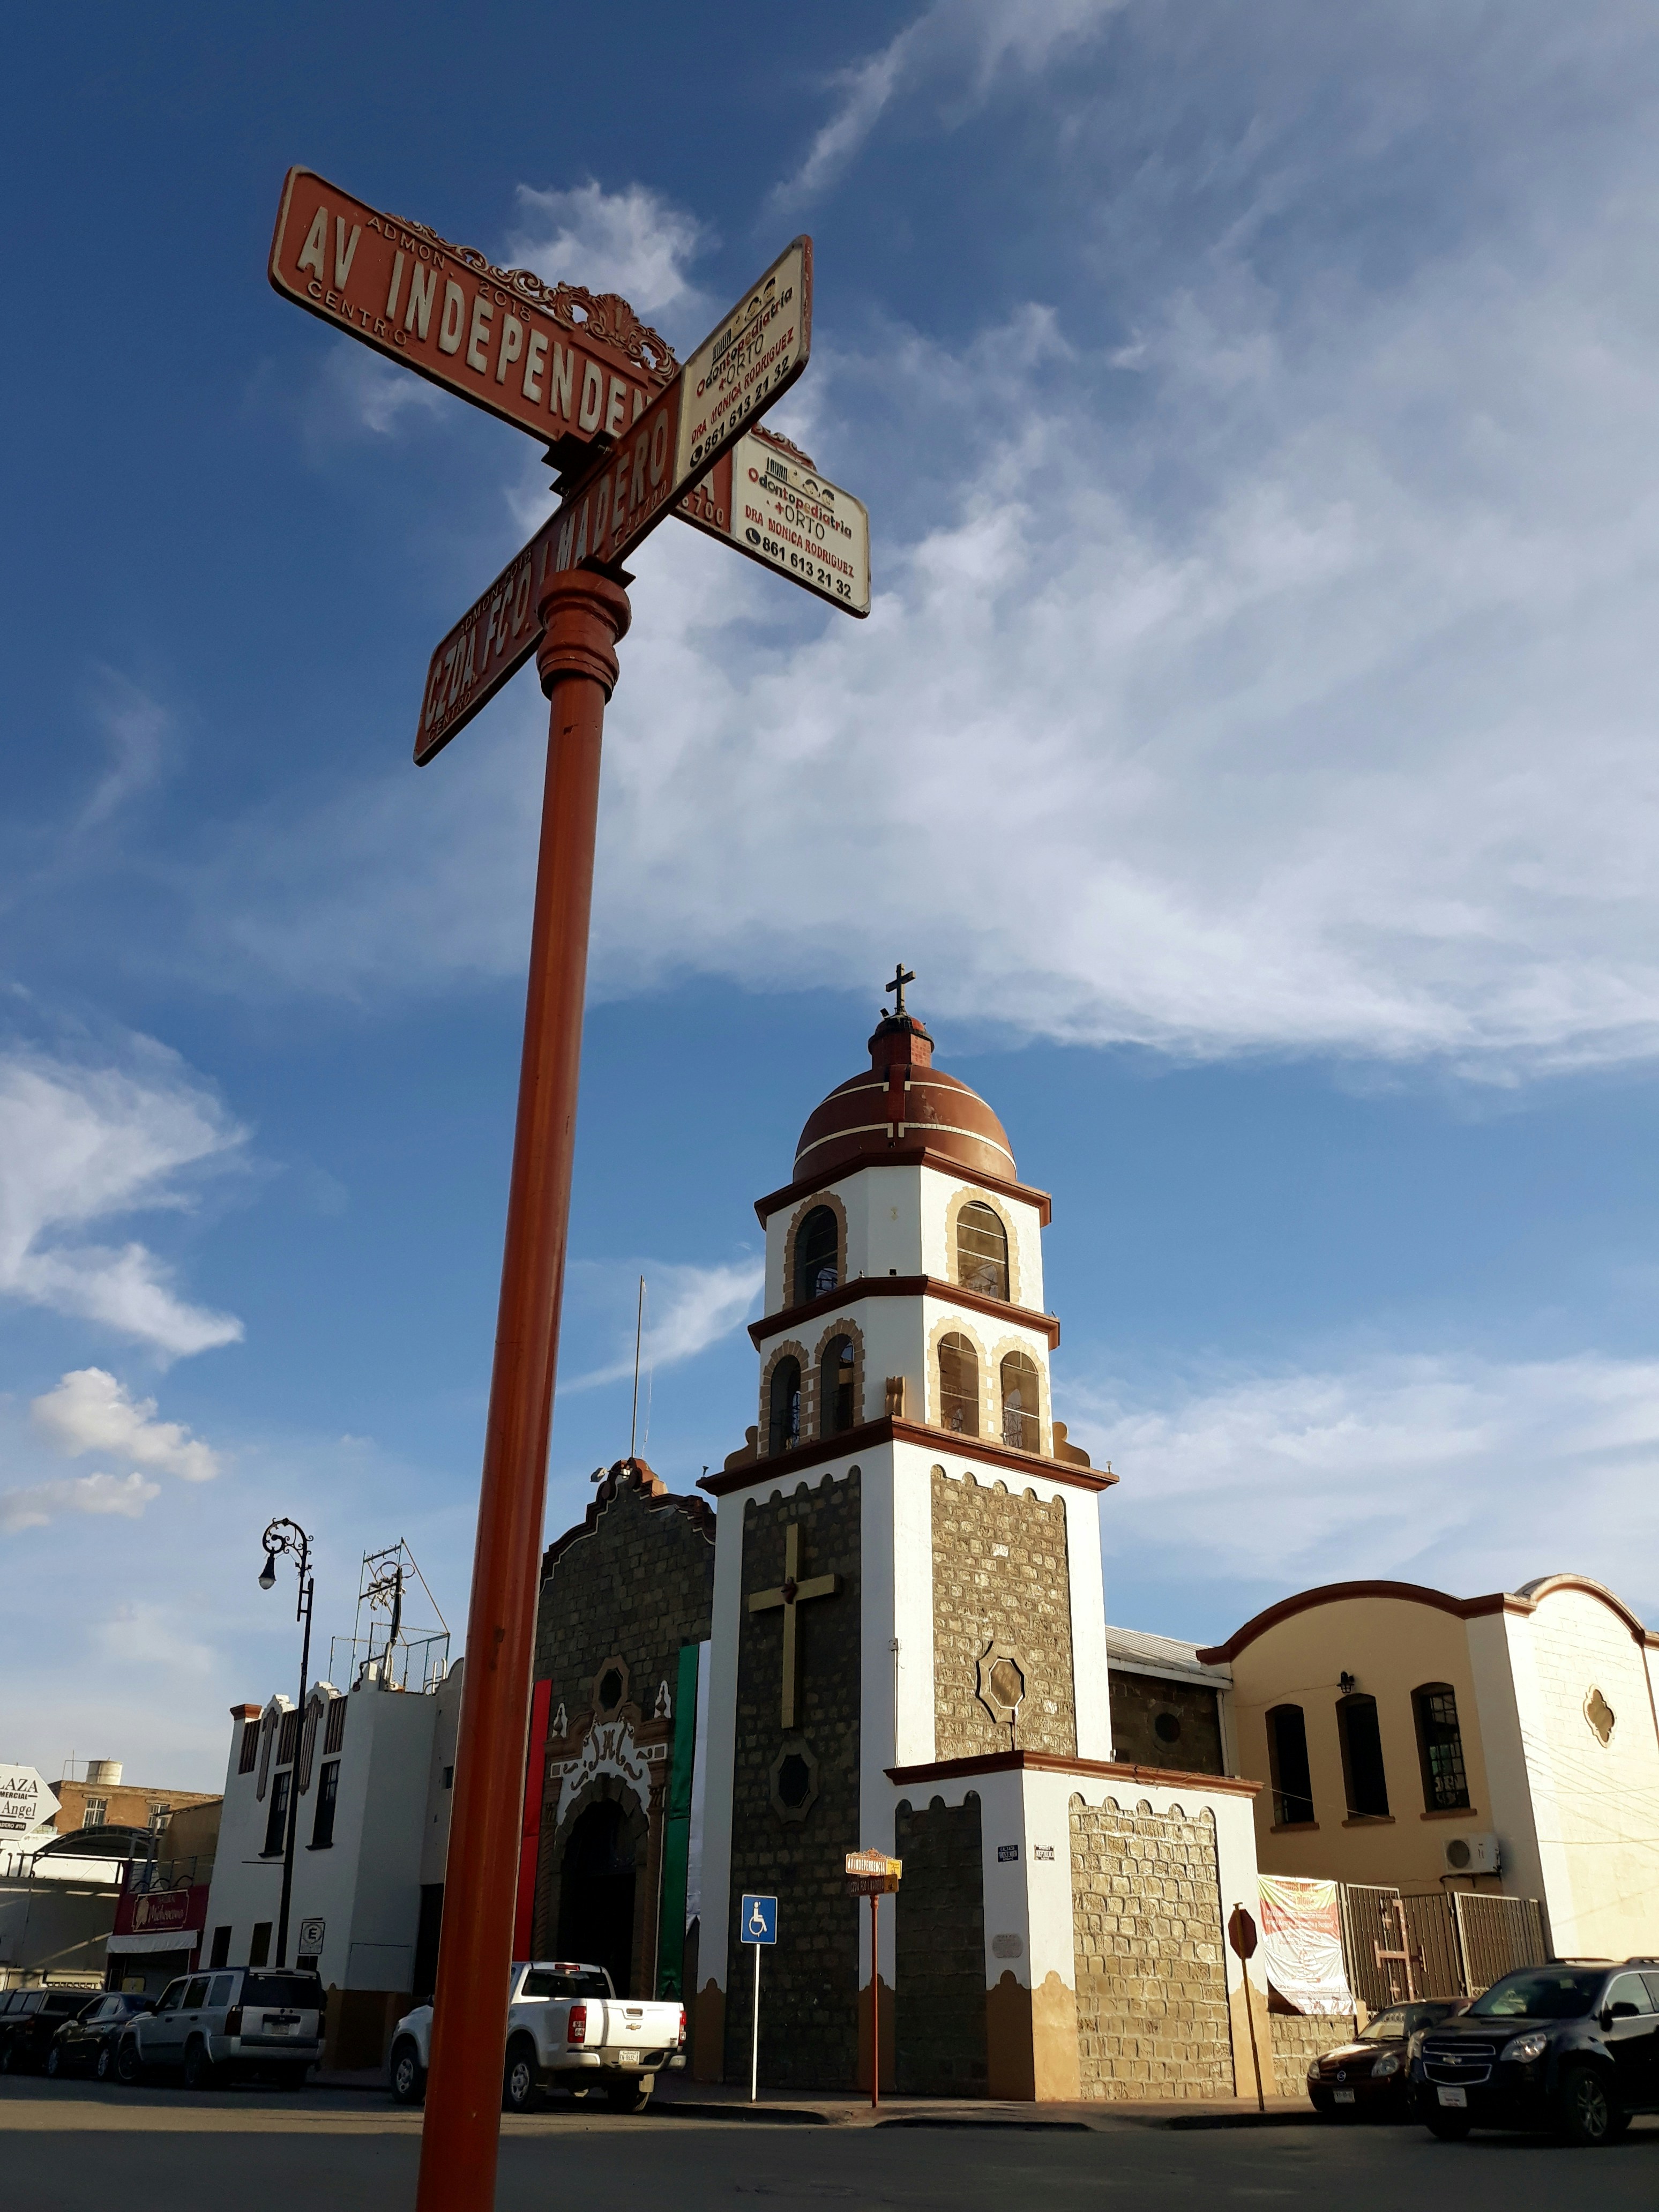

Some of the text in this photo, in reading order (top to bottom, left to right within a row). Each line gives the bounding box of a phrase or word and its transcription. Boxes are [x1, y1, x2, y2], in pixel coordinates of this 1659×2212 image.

[296, 206, 362, 293] AV
[307, 280, 407, 346] CENTRO
[479, 280, 531, 322] 2018
[691, 326, 795, 446] DRA MONICA RODRIGUEZ
[704, 355, 791, 454] 861 613 21 32
[556, 408, 669, 573] MADERO
[748, 467, 852, 541] Odontopediatria
[745, 504, 855, 579] DRA MONICA RODRIGUEZ
[763, 536, 852, 600] 861 613 21 32
[428, 690, 472, 742] CENTRO
[0, 1791, 28, 1799] MERCIAL
[2, 1800, 36, 1819] Angel
[854, 1858, 885, 1873] INDEPENDENCIA
[308, 1927, 318, 1939] E
